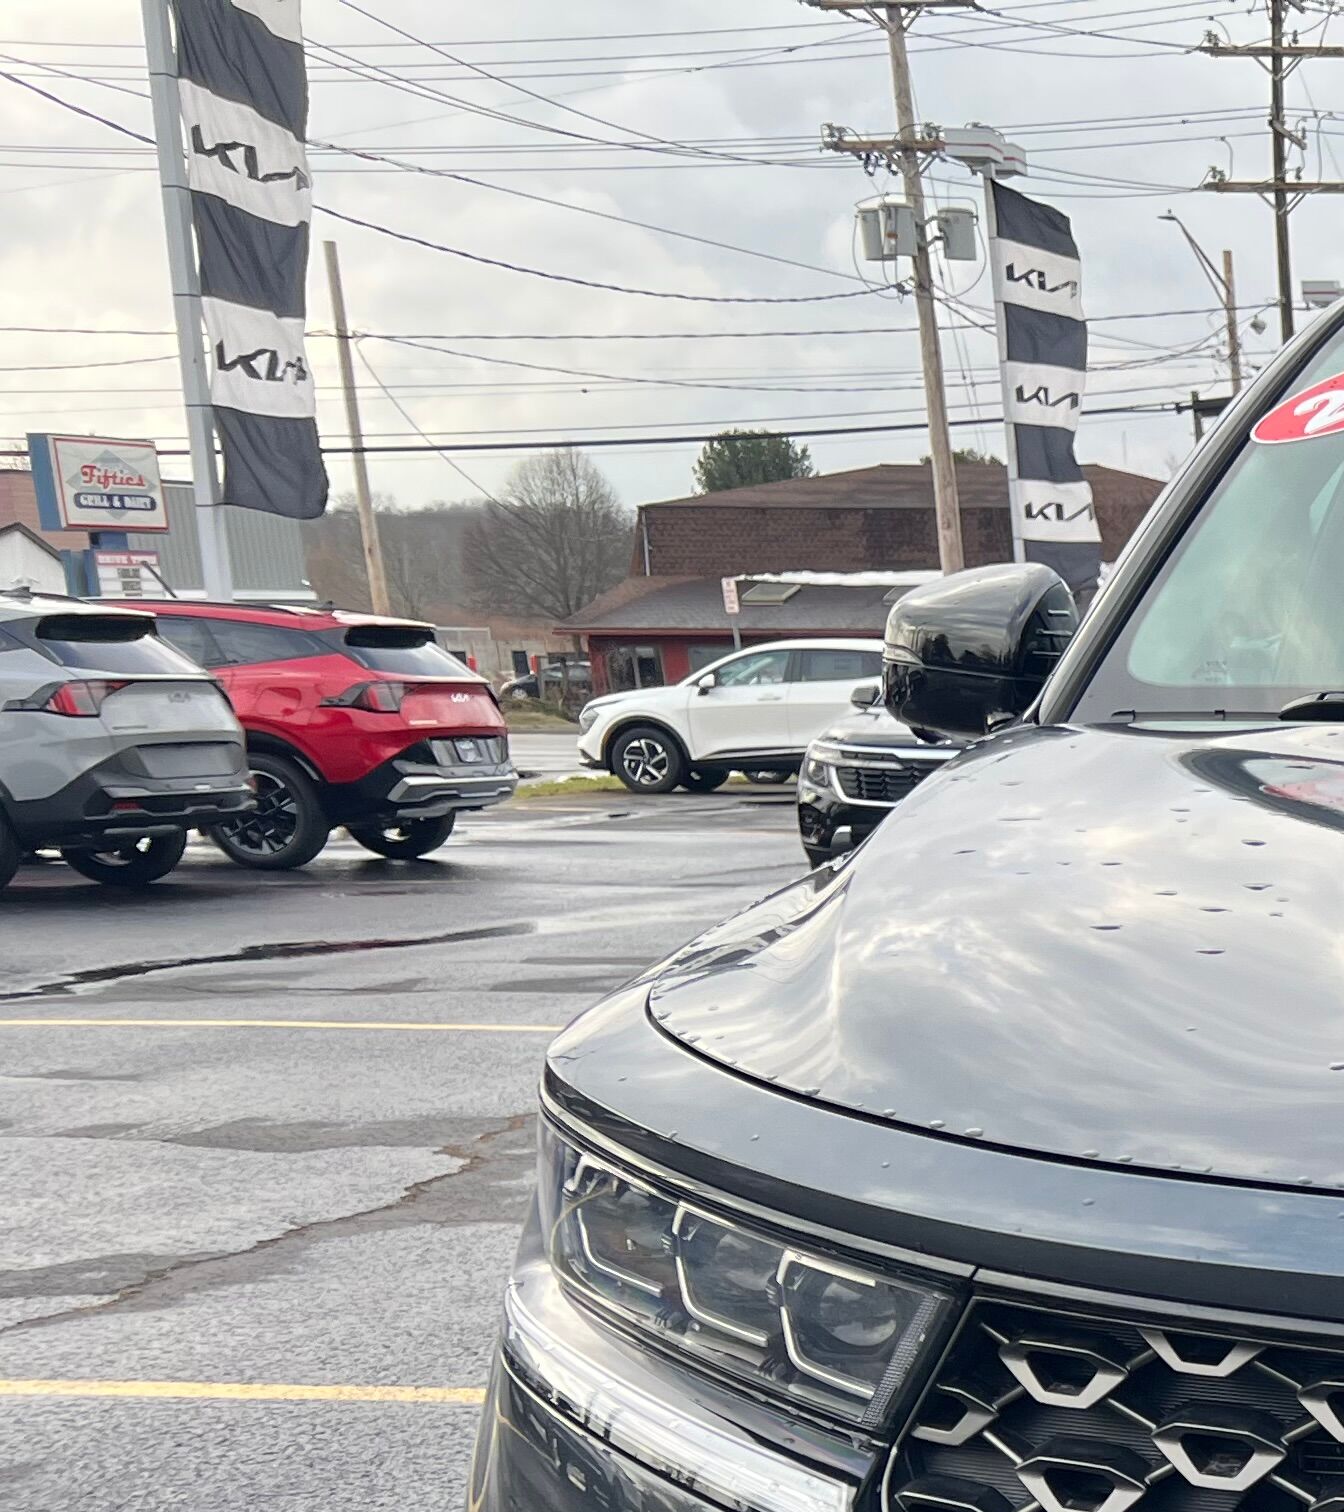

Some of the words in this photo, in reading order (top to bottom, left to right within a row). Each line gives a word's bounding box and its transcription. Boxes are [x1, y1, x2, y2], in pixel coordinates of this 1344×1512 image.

[1006, 263, 1078, 299] KIA
[1015, 384, 1079, 410] KIA
[1025, 501, 1094, 521] KIA
